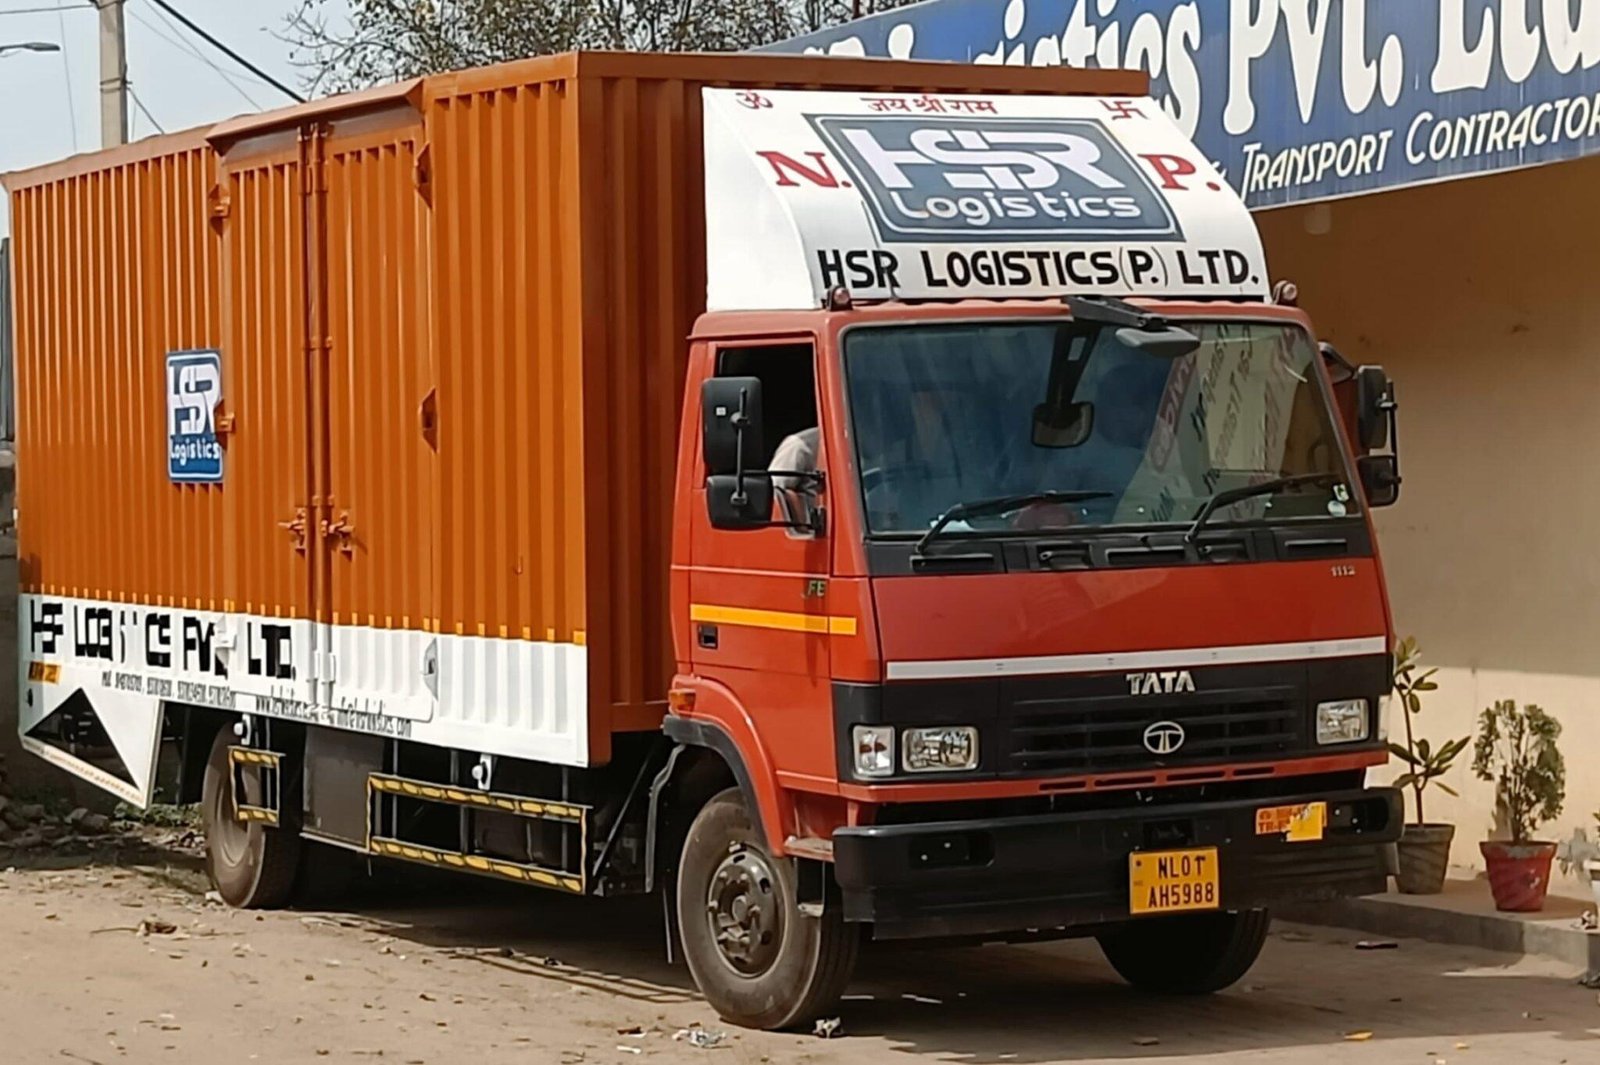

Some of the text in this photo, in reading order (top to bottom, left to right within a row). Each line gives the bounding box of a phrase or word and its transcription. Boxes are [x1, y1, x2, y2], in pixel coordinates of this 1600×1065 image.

[860, 97, 911, 112] जय
[1240, 130, 1393, 202] TRANSPORT
[889, 191, 1142, 226] Logistics
[818, 249, 900, 290] HSR
[1176, 250, 1259, 286] LTD.
[1125, 671, 1196, 696] TATA
[1148, 882, 1214, 908] AH5988
